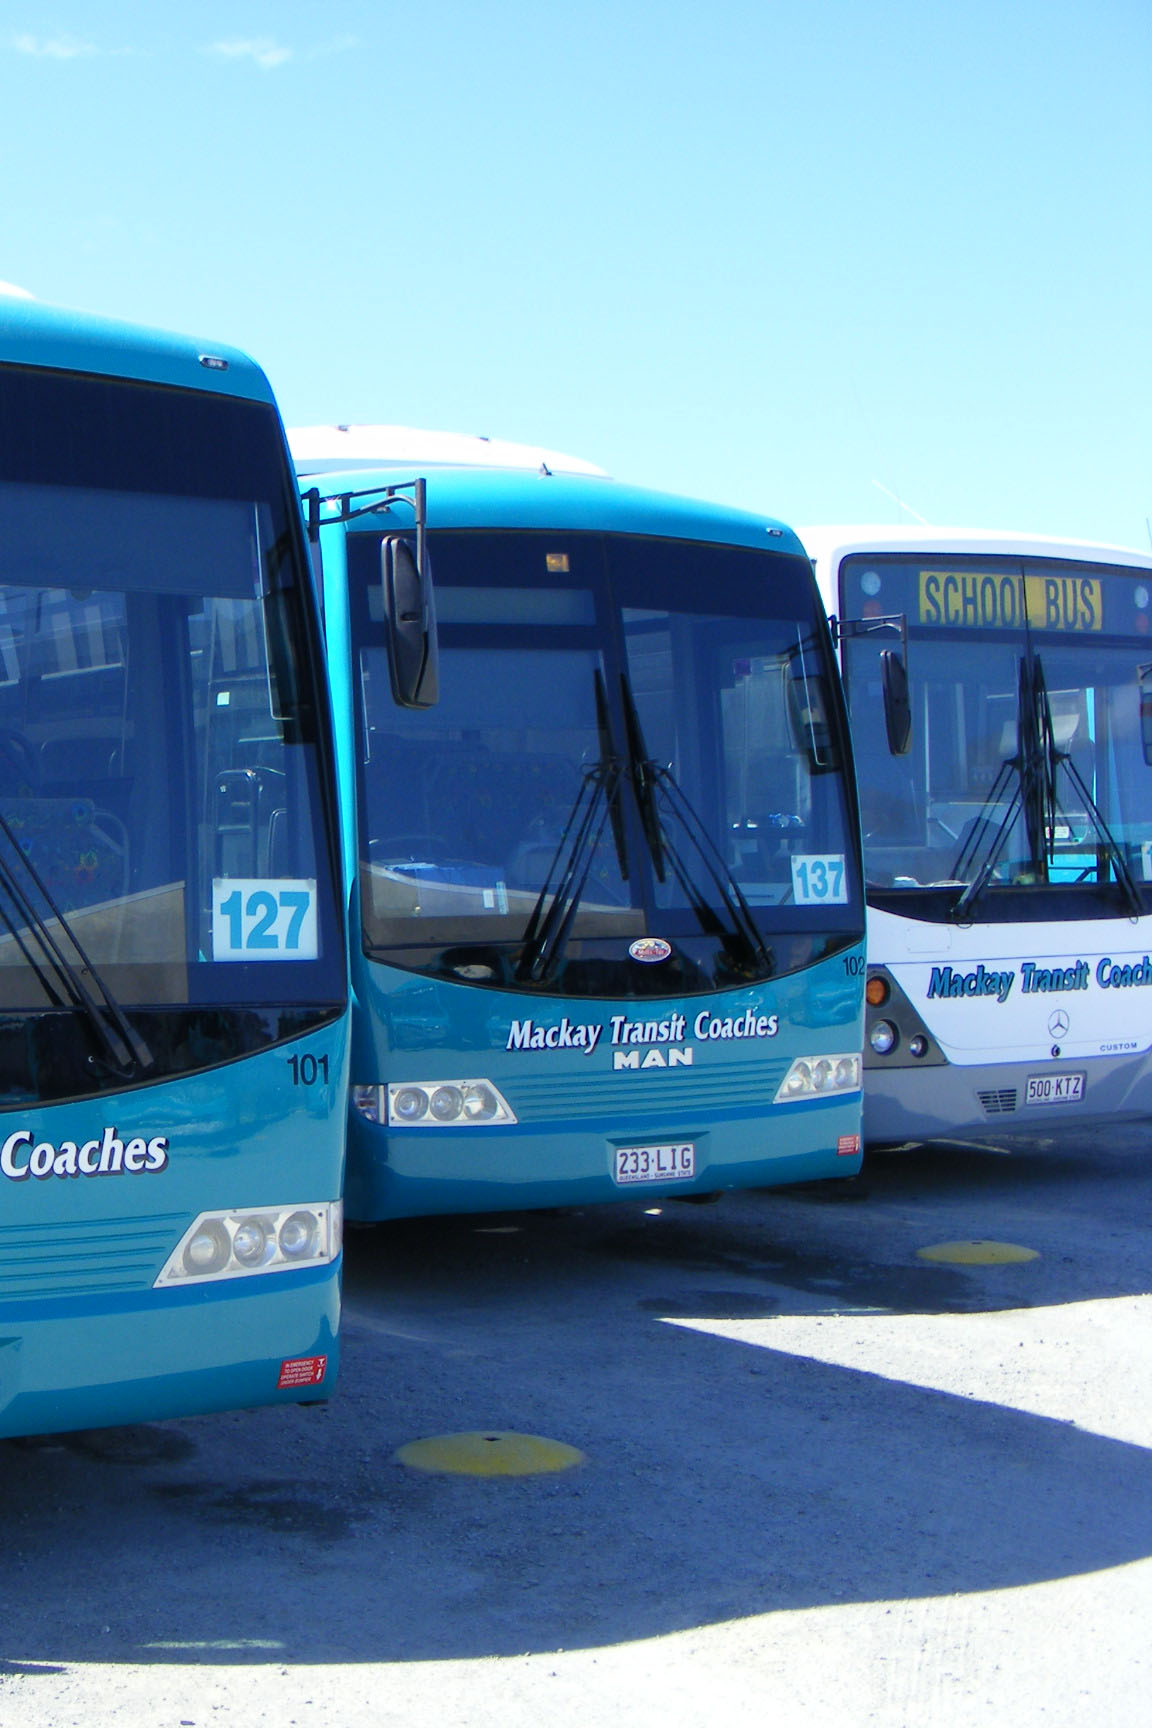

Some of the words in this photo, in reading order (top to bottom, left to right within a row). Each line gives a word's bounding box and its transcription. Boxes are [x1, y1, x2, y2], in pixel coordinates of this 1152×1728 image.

[925, 575, 1032, 627] SCHOOL
[1045, 578, 1095, 630] BUS
[796, 861, 844, 898] 137
[220, 890, 310, 949] 127
[843, 956, 865, 976] 102
[927, 964, 1014, 1003] Mackay
[1020, 960, 1090, 993] Transit
[1096, 956, 1152, 989] Coach
[506, 1018, 602, 1055] Mackay
[610, 1013, 687, 1045] Transit
[694, 1009, 779, 1041] Coaches
[1099, 1042, 1138, 1052] CUSTOM
[287, 1053, 329, 1086] 101
[613, 1047, 693, 1070] MAN
[0, 1126, 170, 1182] Coaches
